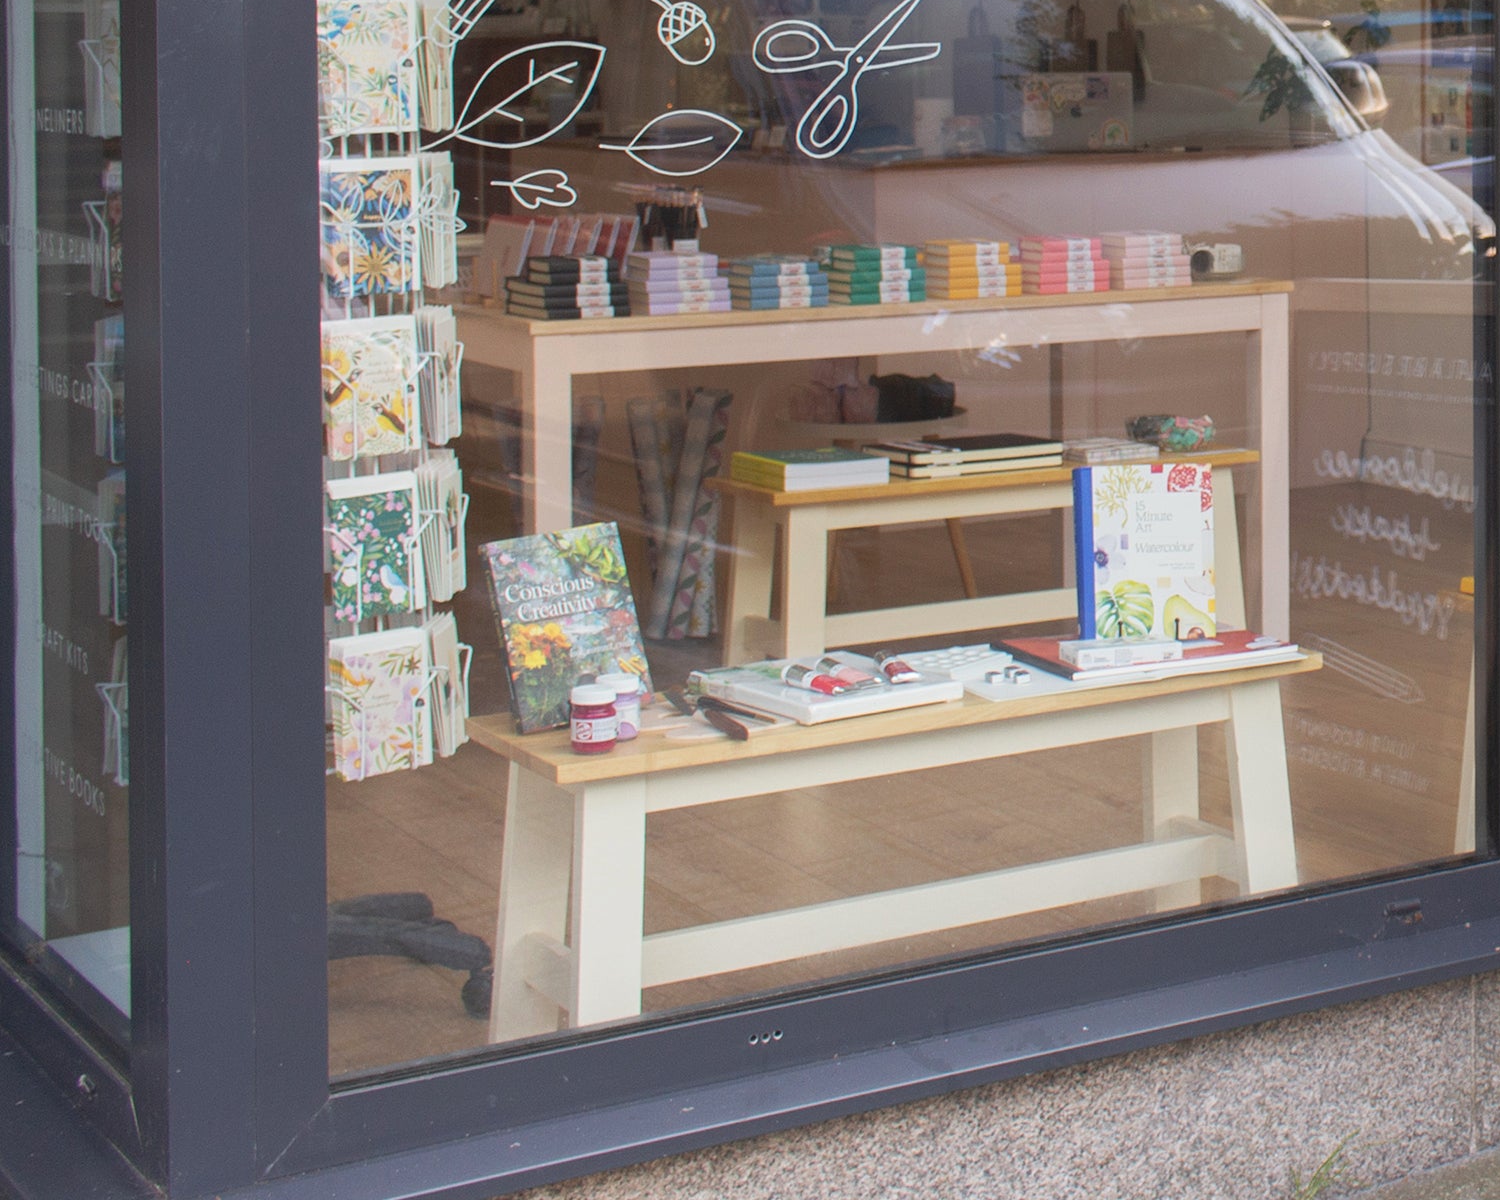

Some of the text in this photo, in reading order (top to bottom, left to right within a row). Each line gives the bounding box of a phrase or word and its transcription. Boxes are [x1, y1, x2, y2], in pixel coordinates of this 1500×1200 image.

[36, 108, 84, 135] NELINERS
[68, 238, 121, 273] PLANNRS
[1135, 511, 1173, 522] Minute
[1135, 522, 1152, 533] Art
[1135, 541, 1195, 554] Watercolour
[505, 576, 595, 604] Conscious
[517, 594, 598, 623] Creativity
[66, 639, 89, 675] KITS
[69, 767, 106, 817] BOOKS
